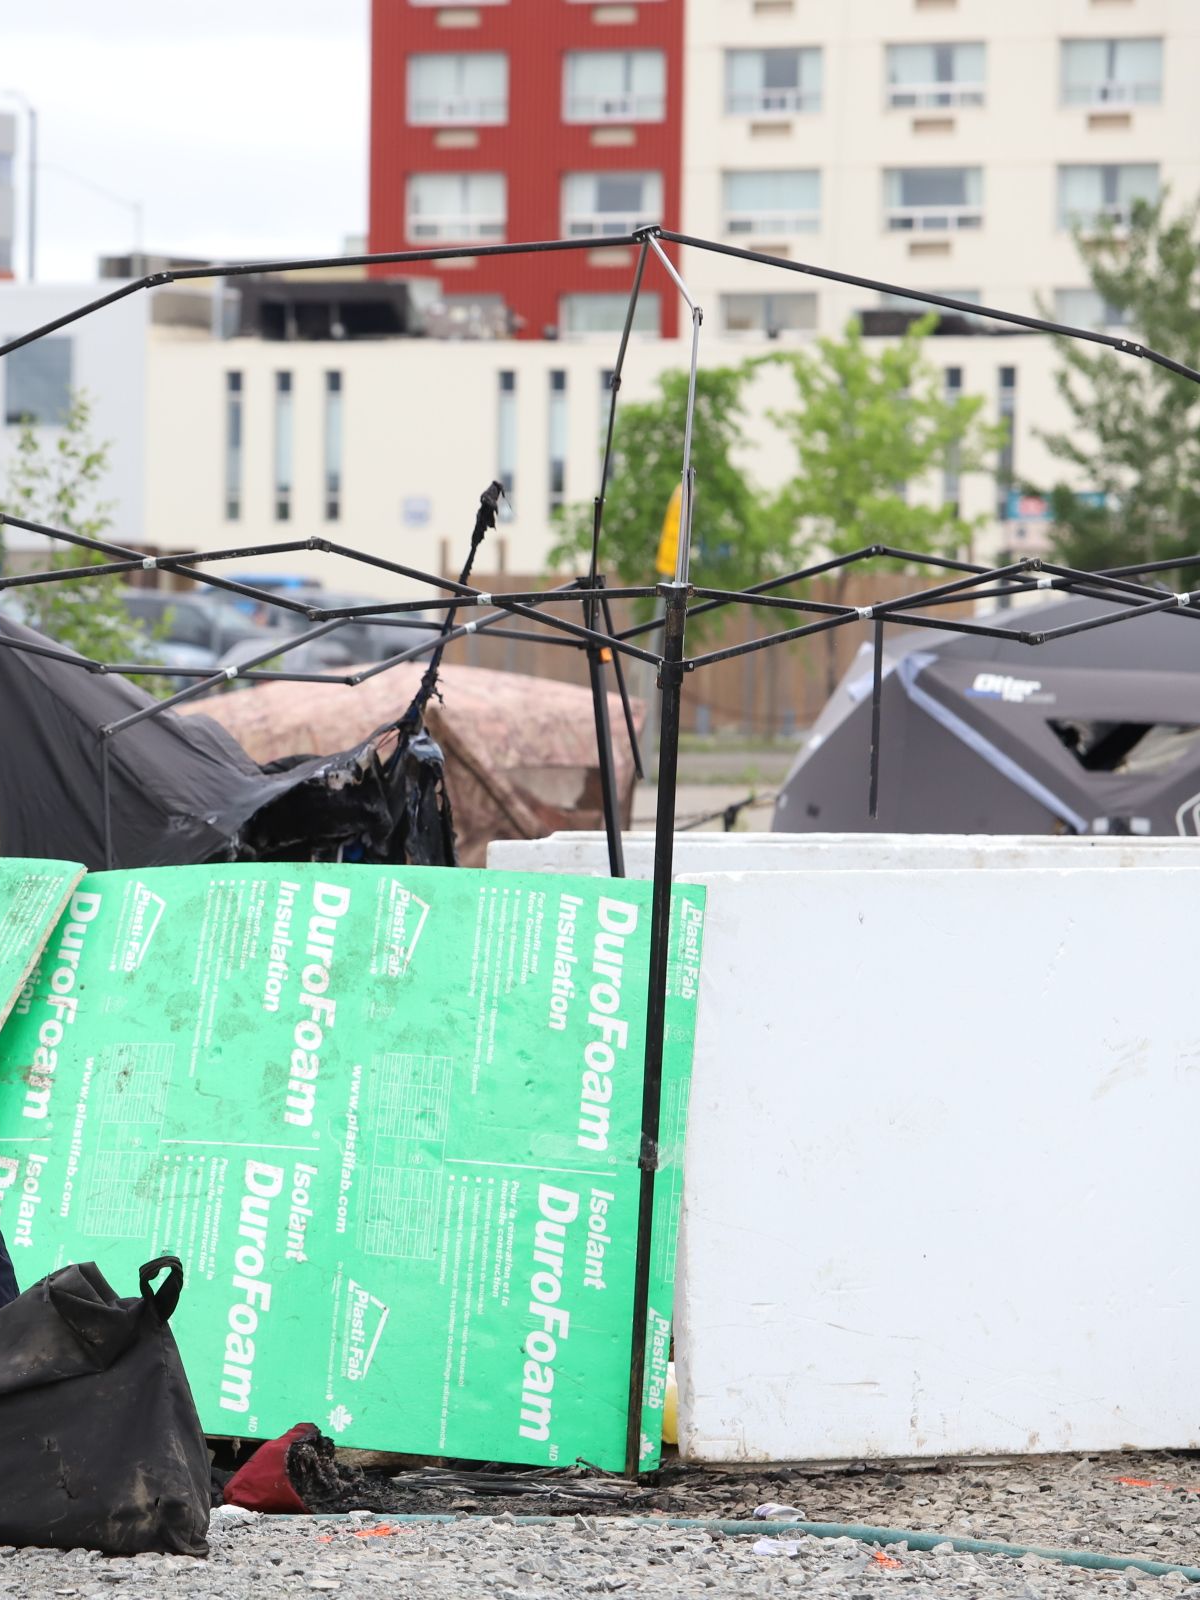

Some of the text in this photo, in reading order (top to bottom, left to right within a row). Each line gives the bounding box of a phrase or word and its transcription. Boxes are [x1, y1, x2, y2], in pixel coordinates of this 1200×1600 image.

[263, 881, 301, 1011] Insulation
[521, 892, 536, 984] New Construction
[534, 912, 544, 951] Retrofit
[549, 894, 583, 1030] Insulation
[22, 892, 102, 1120] DuroFoam
[284, 881, 351, 1126] DuroFoam
[577, 896, 638, 1151] DuroFoam
[60, 1057, 94, 1216] www.plastifab.com
[335, 1064, 362, 1234] www.plastifab.com
[14, 1154, 48, 1247] Isolant
[199, 1205, 211, 1272] construction
[286, 1163, 318, 1262] Isolant
[493, 1180, 509, 1297] nouvelle construction
[509, 1209, 517, 1218] la
[510, 1181, 520, 1205] Pour
[584, 1188, 614, 1290] Isolant
[220, 1160, 284, 1413] DuroFoam
[502, 1296, 509, 1307] la
[503, 1282, 509, 1293] et
[519, 1182, 579, 1440] DuroFoam
[550, 1445, 560, 1461] MD
